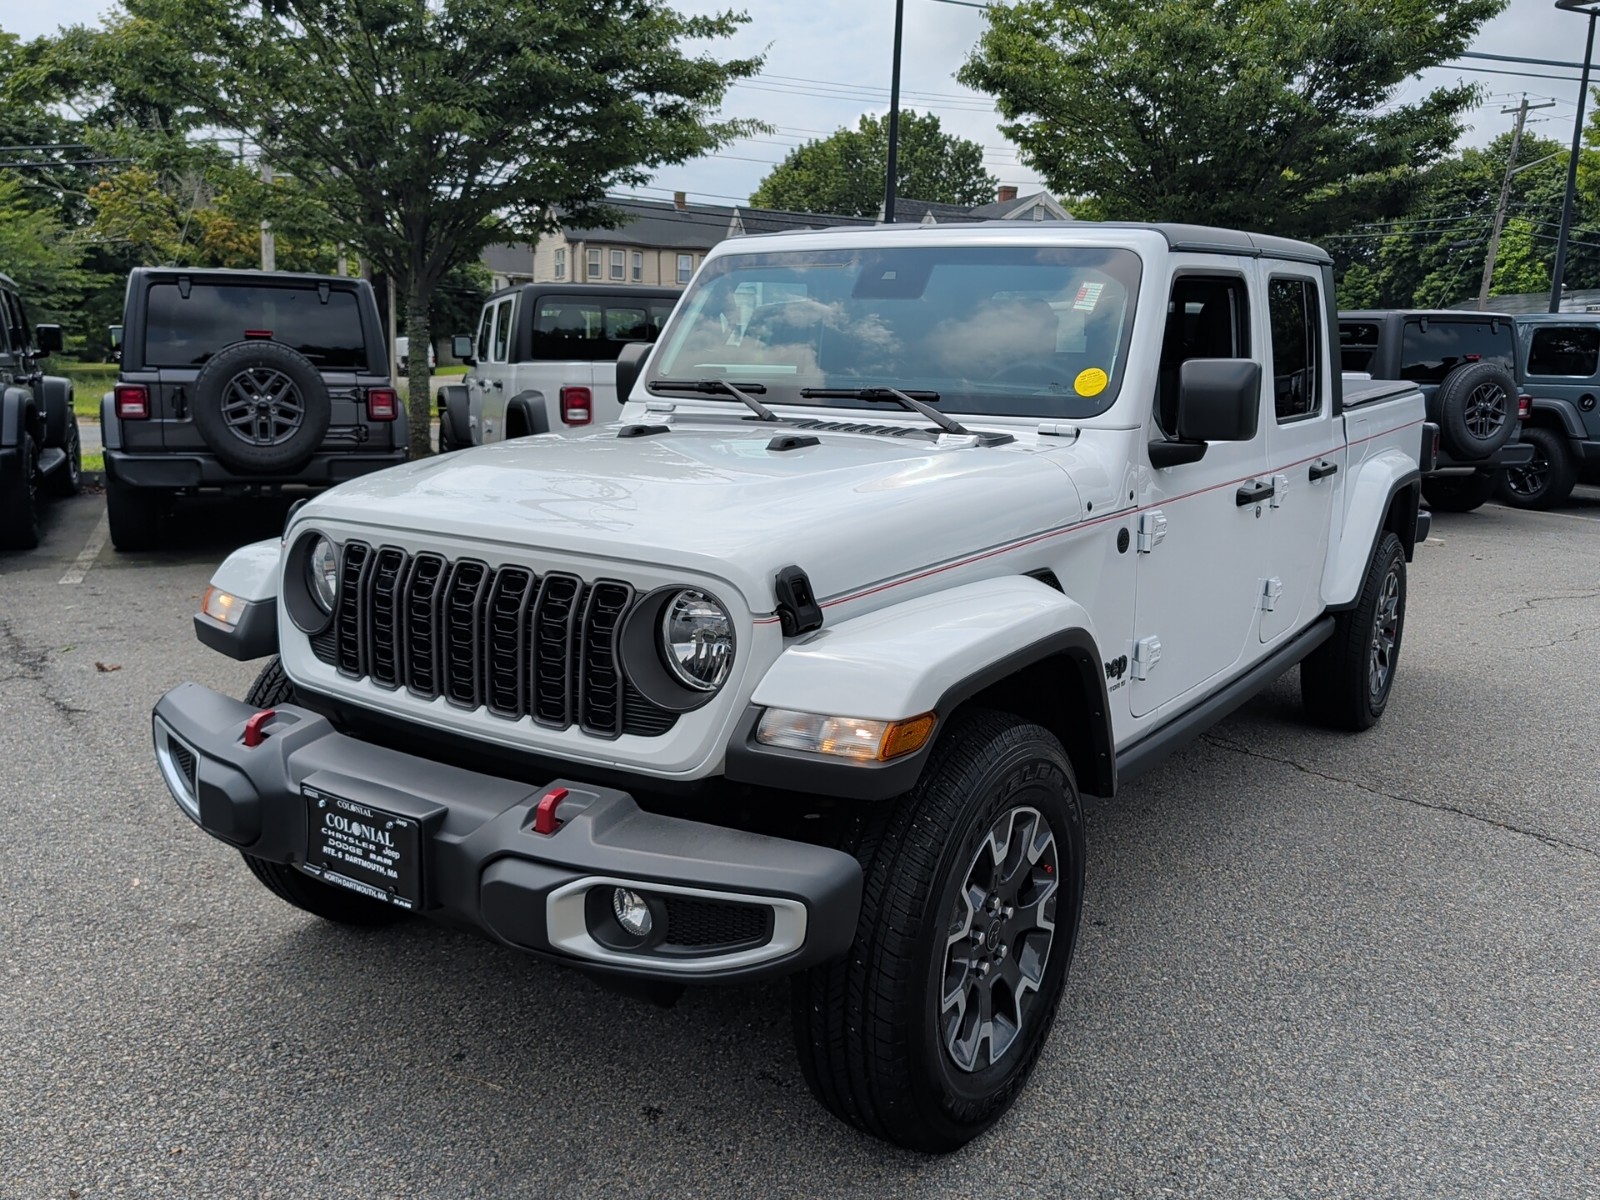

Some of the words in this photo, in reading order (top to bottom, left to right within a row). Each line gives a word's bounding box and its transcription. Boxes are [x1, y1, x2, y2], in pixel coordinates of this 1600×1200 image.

[1104, 655, 1127, 680] eep
[326, 813, 394, 847] COLONIAL
[321, 828, 376, 850] CHRYSLER
[382, 846, 400, 860] Jeep
[328, 839, 363, 856] DODGE
[370, 853, 393, 866] RAM
[324, 872, 342, 885] NORTH
[387, 869, 398, 878] MA
